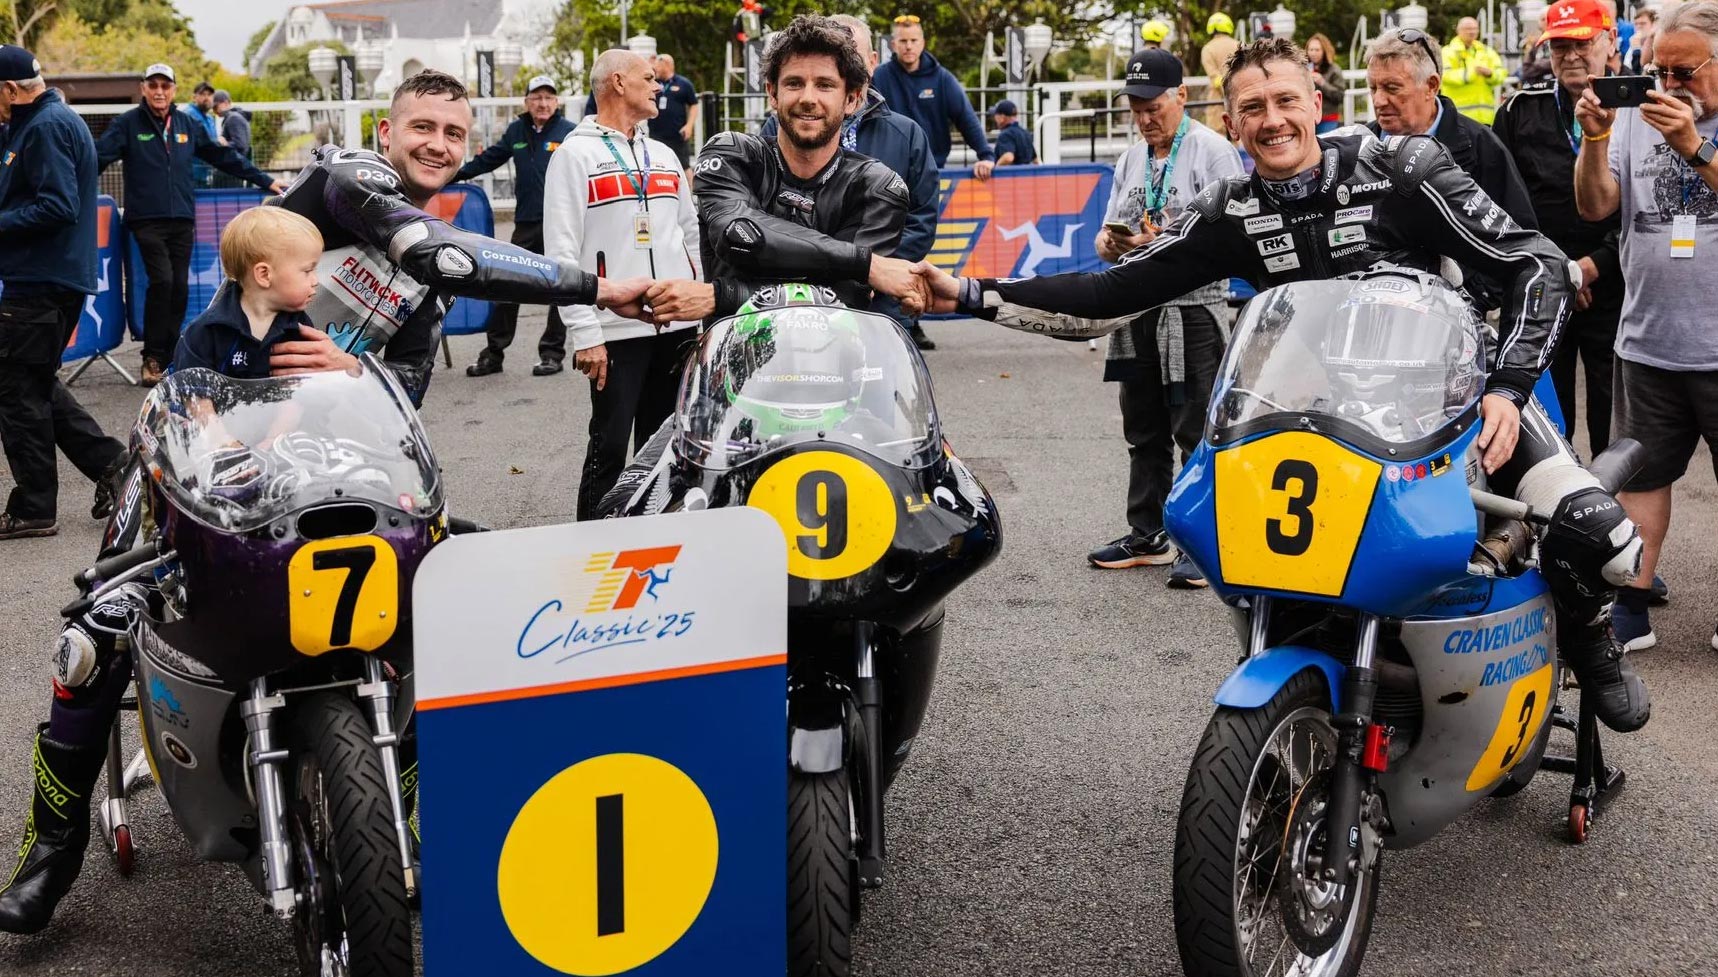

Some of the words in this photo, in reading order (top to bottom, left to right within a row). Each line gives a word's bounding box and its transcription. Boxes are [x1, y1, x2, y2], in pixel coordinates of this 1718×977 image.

[1320, 156, 1336, 194] RACING
[1351, 179, 1392, 194] MOTUL
[1247, 217, 1280, 226] HONDA
[1291, 212, 1324, 224] SPADA
[1336, 208, 1371, 219] PROCare
[1262, 236, 1288, 251] RK
[482, 250, 552, 271] CorraMore
[1365, 281, 1405, 292] SHOEI
[786, 321, 828, 331] FAKRO
[1018, 318, 1089, 334] SADA
[756, 374, 844, 384] THEVISORSHOP.COM
[795, 470, 848, 560] 9
[1265, 459, 1319, 556] 3
[1573, 502, 1619, 519] SPADA
[313, 545, 377, 647] 7
[517, 600, 656, 659] Classic
[1443, 624, 1510, 655] CRAVEN
[1512, 606, 1546, 640] CLASSIC
[1479, 651, 1528, 687] RACING
[1500, 690, 1536, 769] 3
[595, 792, 625, 937] 1
